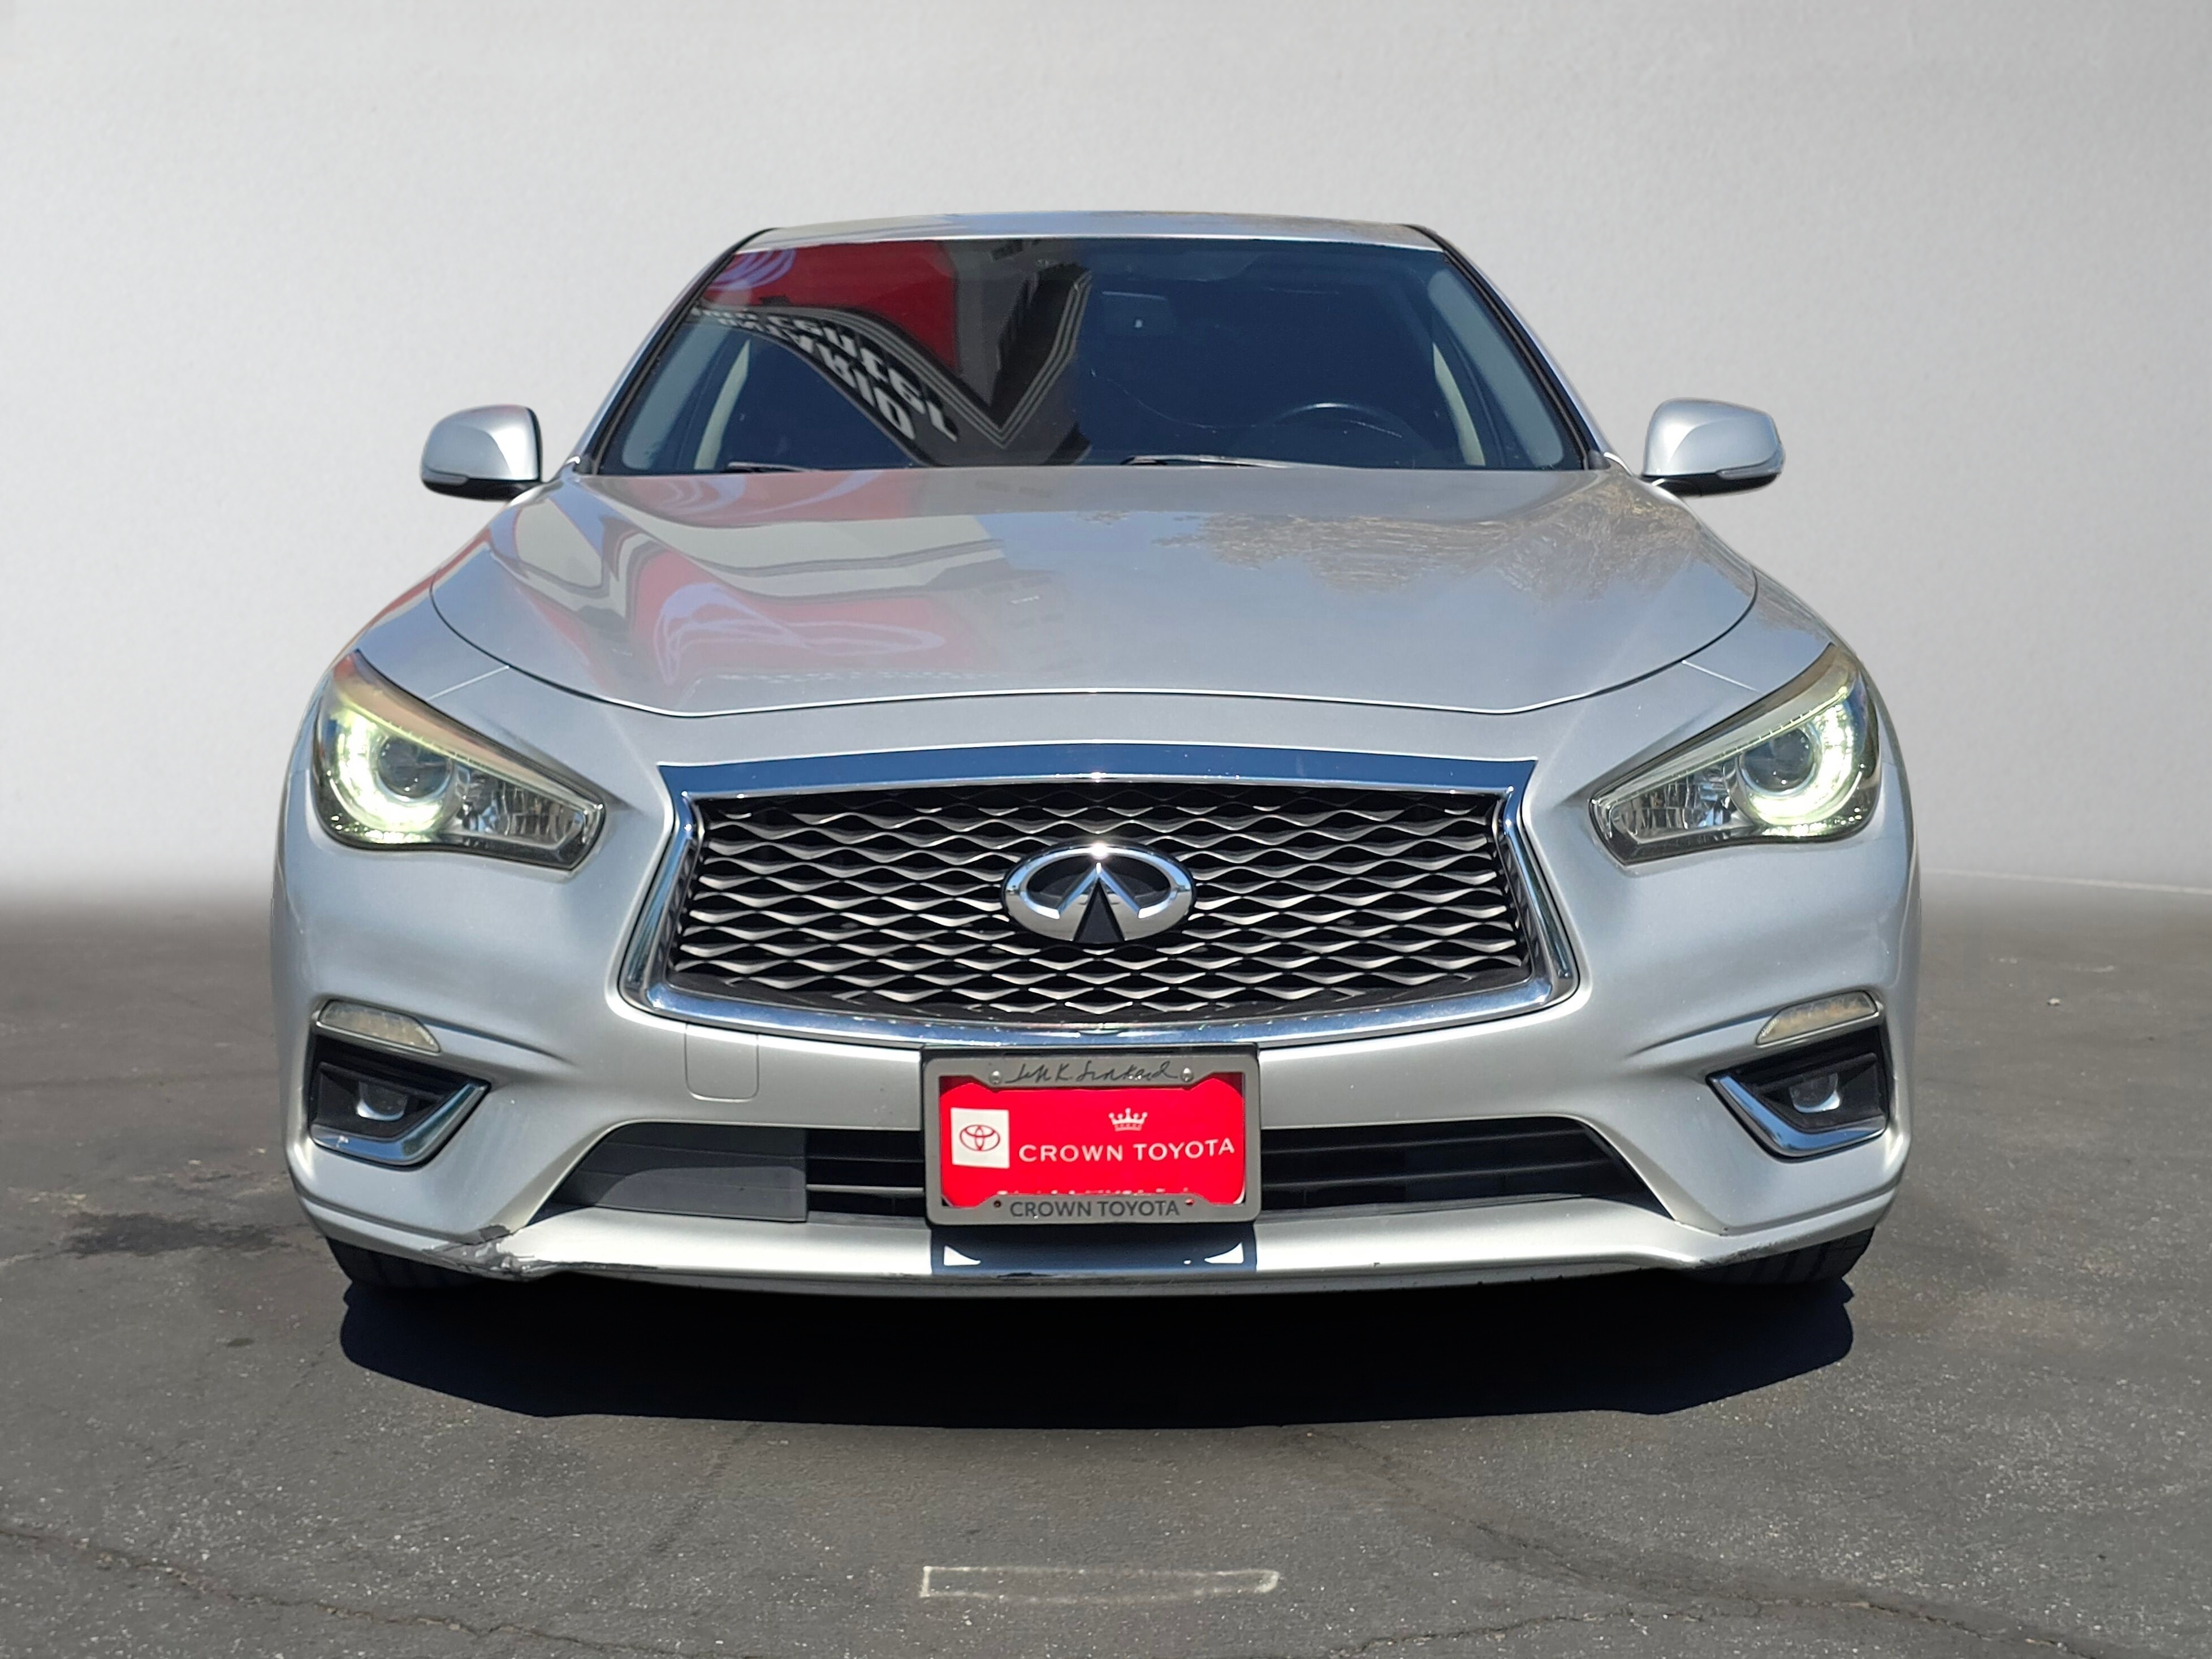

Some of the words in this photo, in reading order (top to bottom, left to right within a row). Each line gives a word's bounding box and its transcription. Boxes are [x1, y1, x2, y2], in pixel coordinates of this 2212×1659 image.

[1018, 1143, 1124, 1163] CROWN
[1132, 1137, 1235, 1161] TOYOTA
[1009, 1201, 1091, 1217] CROWN
[1097, 1200, 1181, 1217] TOYOTA
